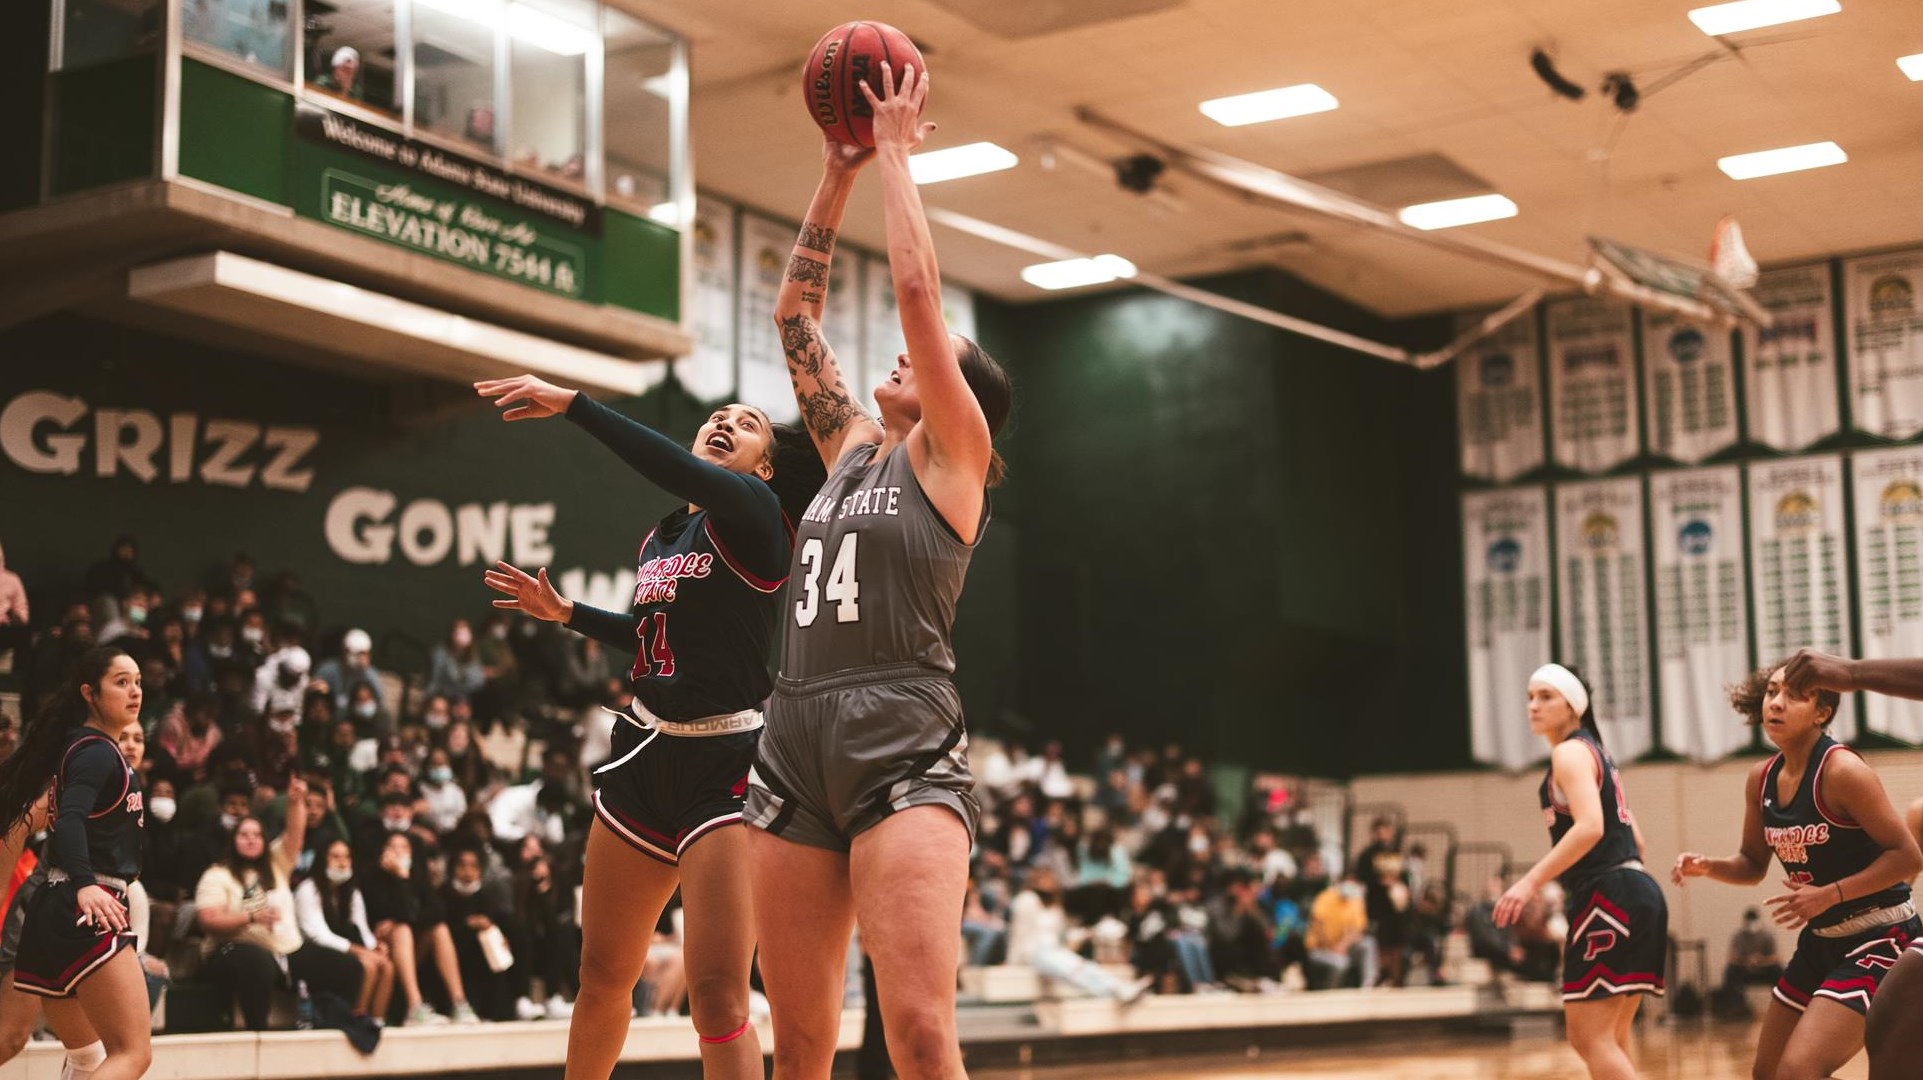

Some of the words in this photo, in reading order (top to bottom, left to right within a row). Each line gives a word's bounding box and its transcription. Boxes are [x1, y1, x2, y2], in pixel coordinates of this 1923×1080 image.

[815, 38, 843, 126] Wilson
[322, 112, 398, 161] Welcome
[398, 144, 419, 168] to
[419, 149, 471, 186] Adams
[332, 190, 490, 265] ELEVATION
[838, 486, 901, 520] STATE
[795, 531, 860, 629] 34
[631, 612, 675, 682] 14
[1583, 929, 1616, 961] P
